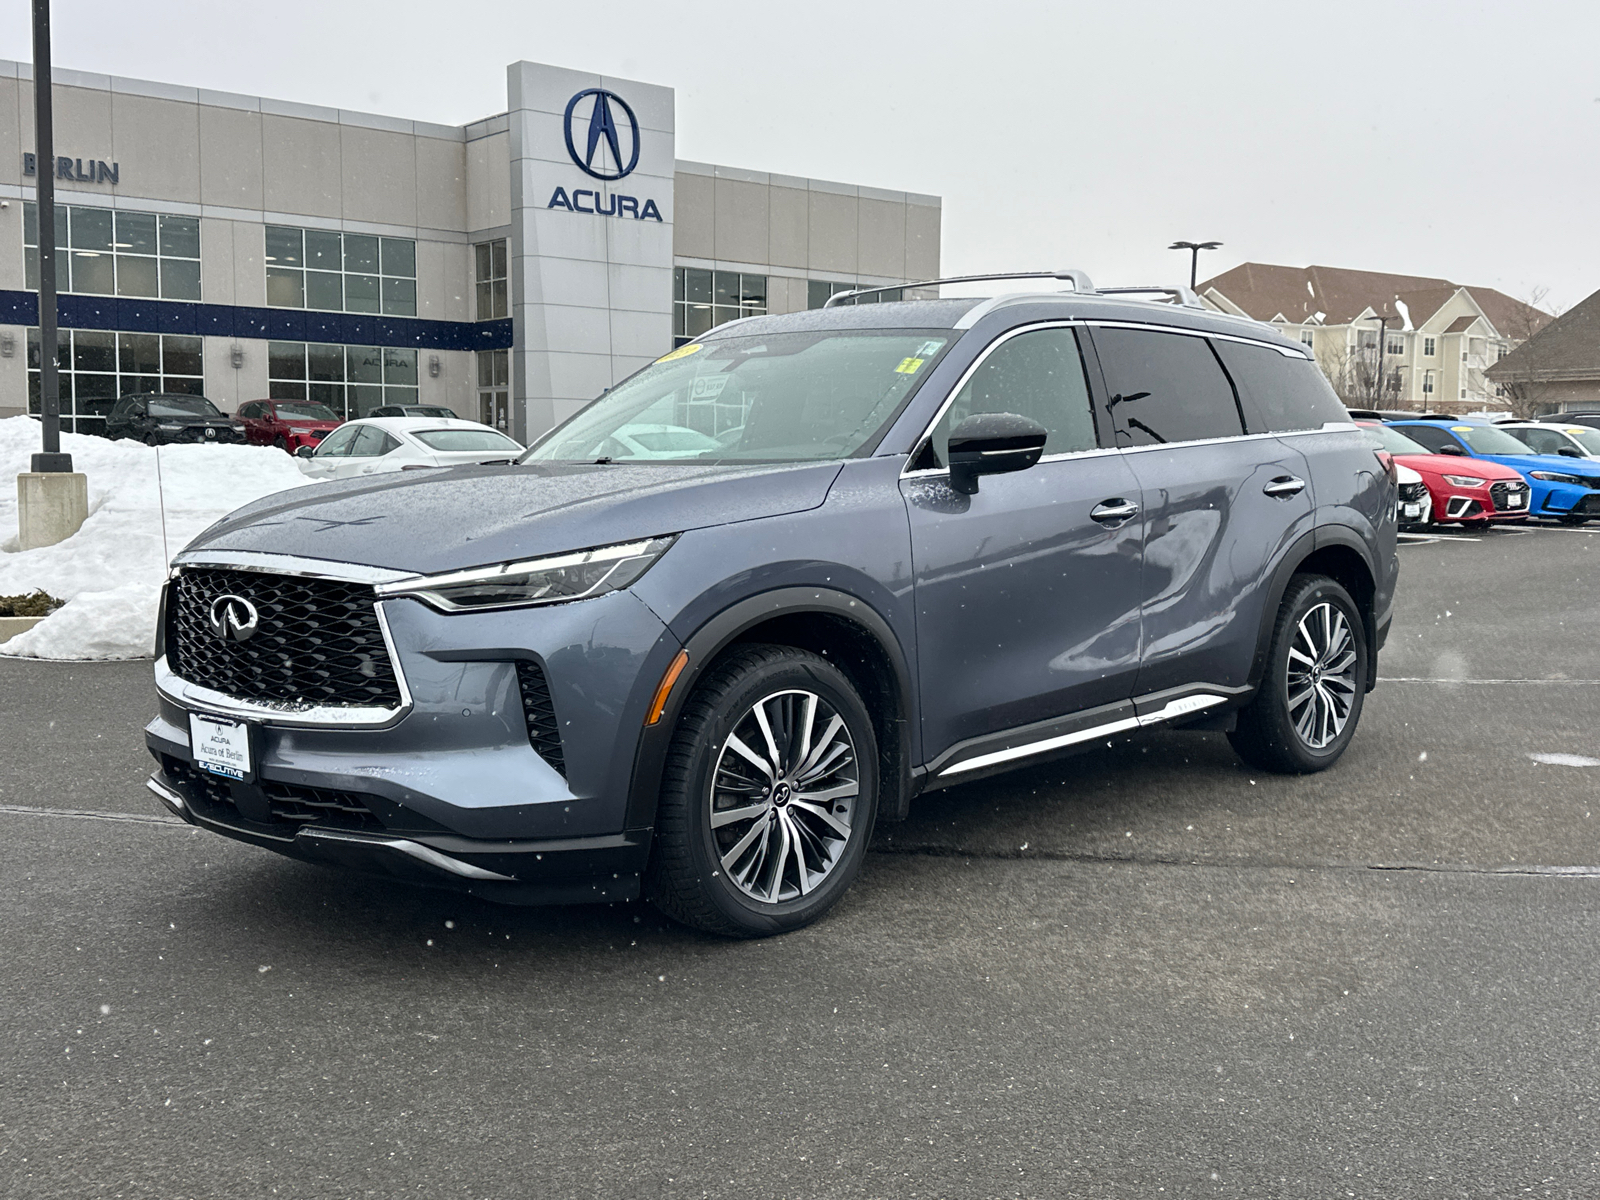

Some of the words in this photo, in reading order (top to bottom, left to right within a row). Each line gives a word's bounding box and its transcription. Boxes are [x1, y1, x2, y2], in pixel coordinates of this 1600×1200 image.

[23, 152, 119, 184] BRLIN
[547, 186, 663, 222] ACURA
[211, 736, 230, 745] ACURA
[200, 743, 217, 756] Acura
[218, 747, 225, 758] of
[226, 747, 243, 762] Berlin
[198, 761, 243, 778] EXECUTIVE
